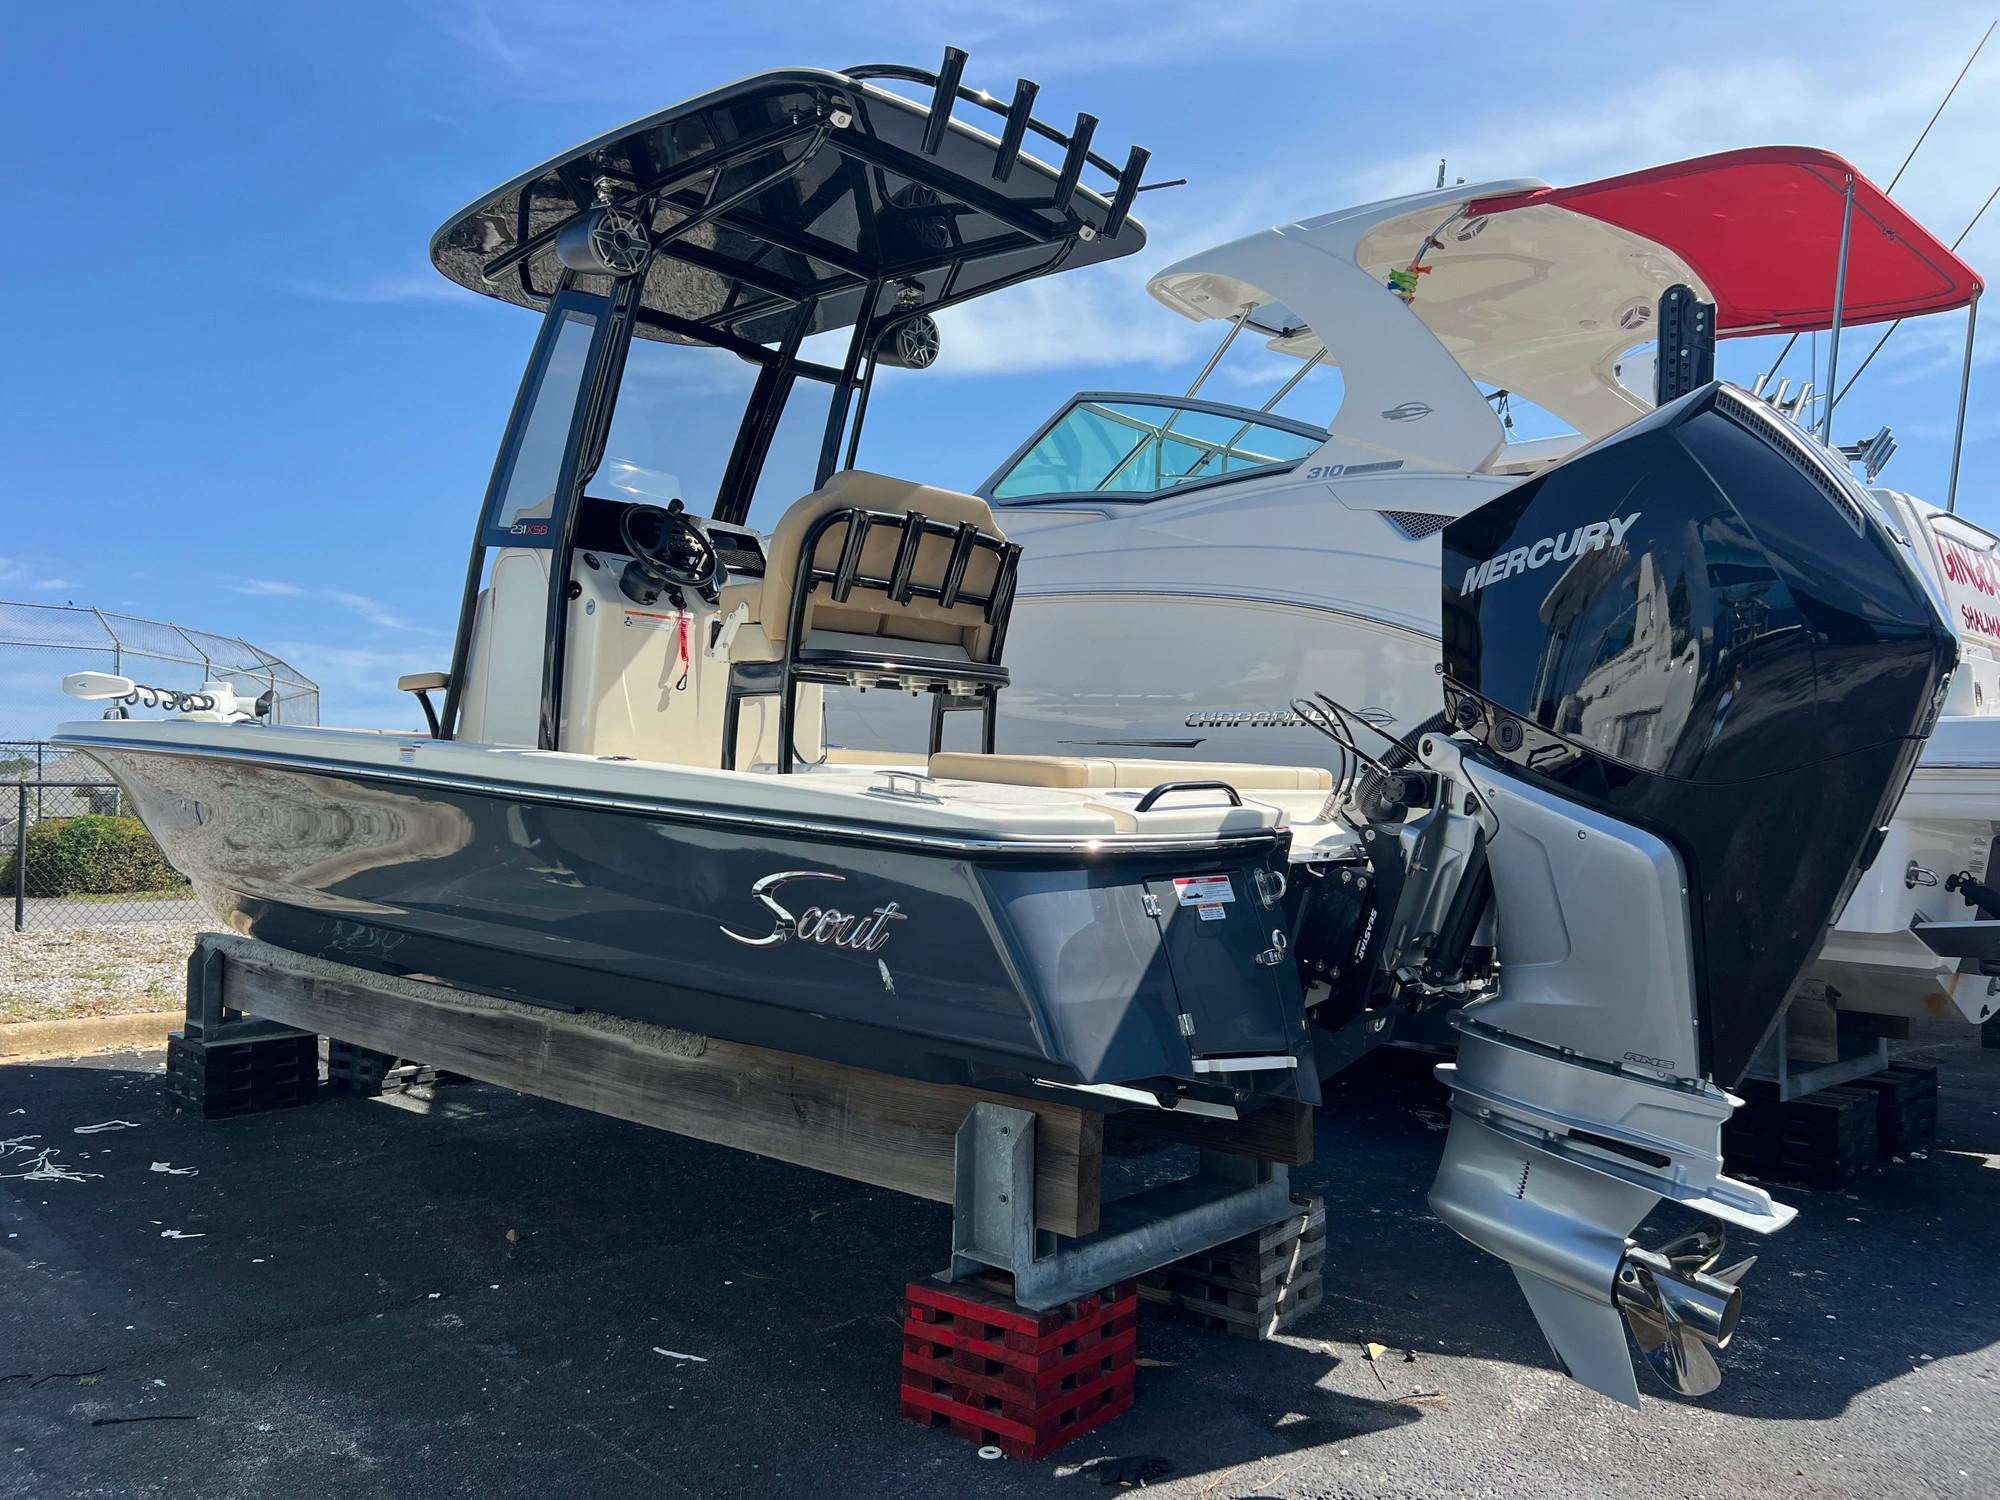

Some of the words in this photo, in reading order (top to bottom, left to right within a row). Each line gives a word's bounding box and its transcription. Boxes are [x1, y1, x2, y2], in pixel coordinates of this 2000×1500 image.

[1307, 465, 1344, 479] 310
[1460, 512, 1641, 596] MERCURY
[719, 870, 908, 951] Scout
[1358, 908, 1377, 960] SEASTAR
